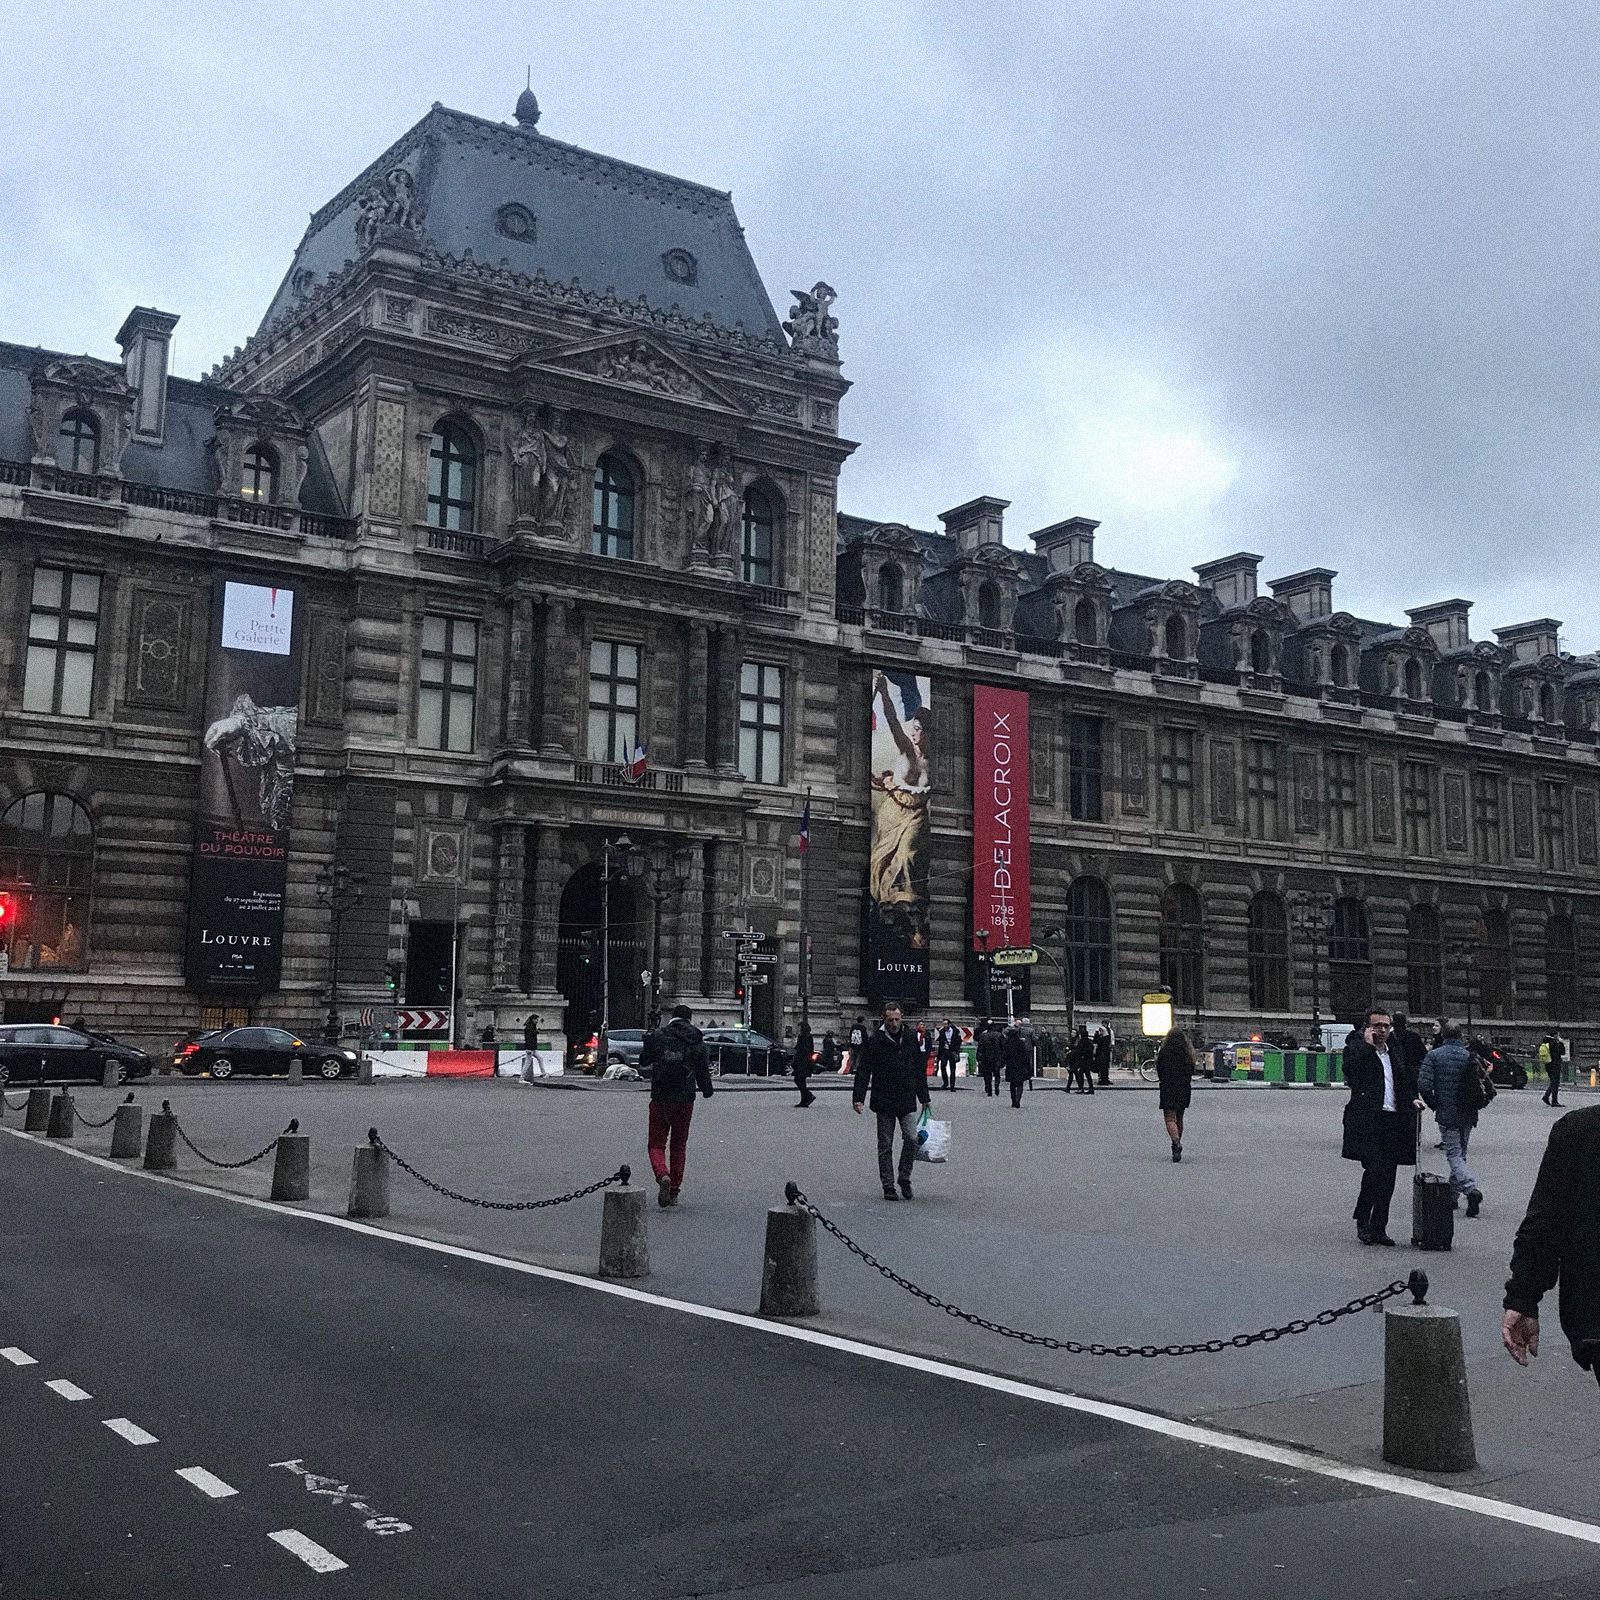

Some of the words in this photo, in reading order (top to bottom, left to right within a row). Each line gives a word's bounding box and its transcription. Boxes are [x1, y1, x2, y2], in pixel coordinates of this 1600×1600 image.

[250, 619, 286, 634] Petite
[235, 630, 280, 645] Galerie
[993, 711, 1012, 889] DELACROIX
[200, 842, 220, 853] DU
[224, 844, 285, 857] POUVOIR
[991, 904, 1015, 915] 1798
[991, 916, 1015, 927] 1863
[201, 929, 272, 946] LOUVRE
[877, 958, 923, 973] LOUVRE
